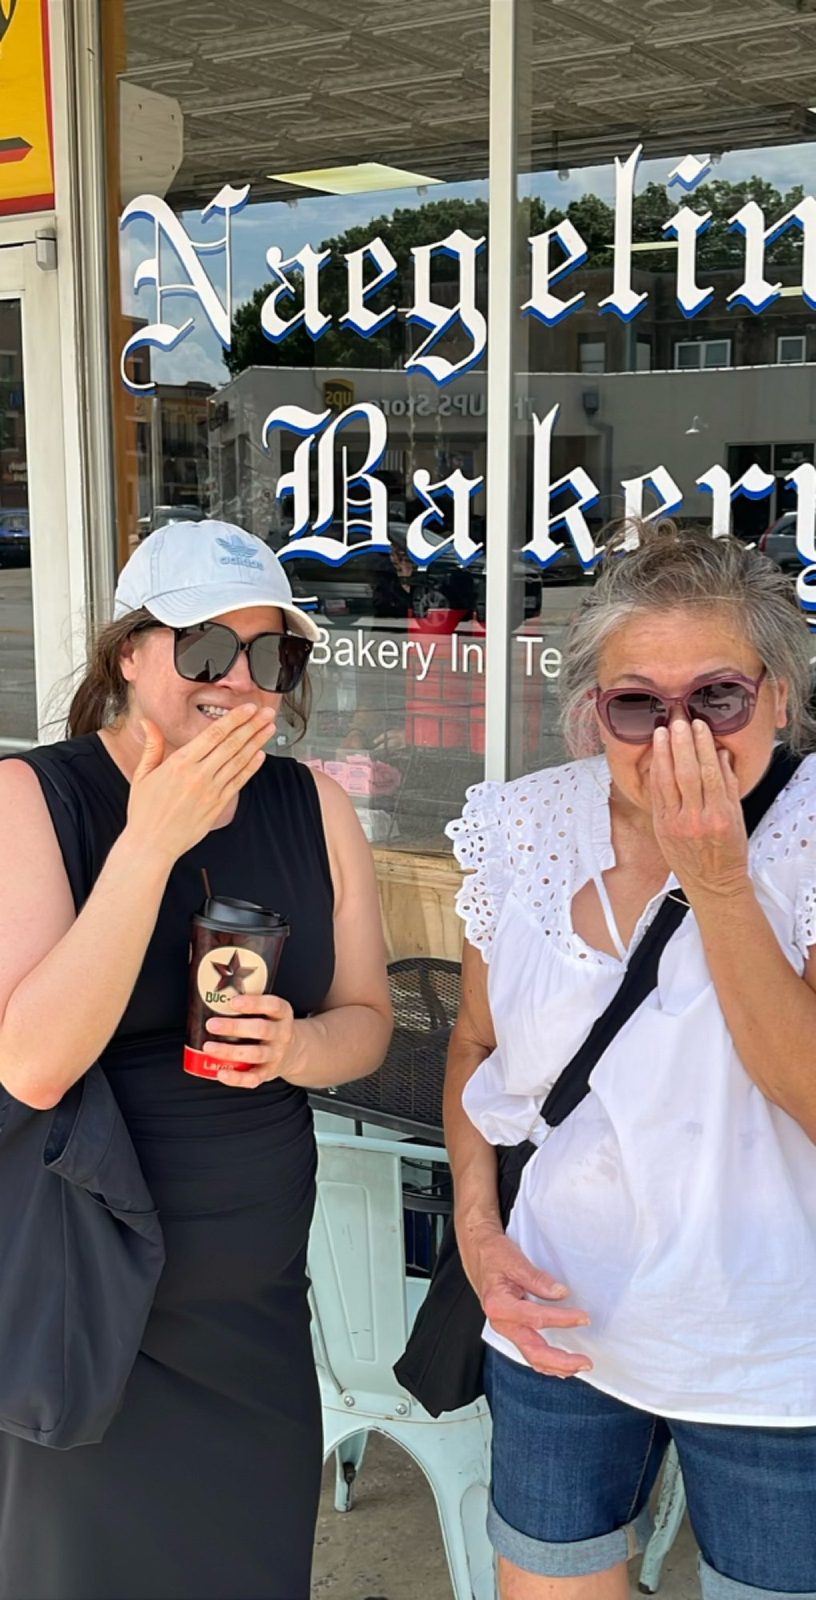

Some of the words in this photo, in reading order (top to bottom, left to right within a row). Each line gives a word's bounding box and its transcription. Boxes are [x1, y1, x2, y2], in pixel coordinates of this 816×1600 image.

[309, 627, 436, 681] Bakery
[452, 634, 483, 673] In
[516, 636, 562, 678] Te
